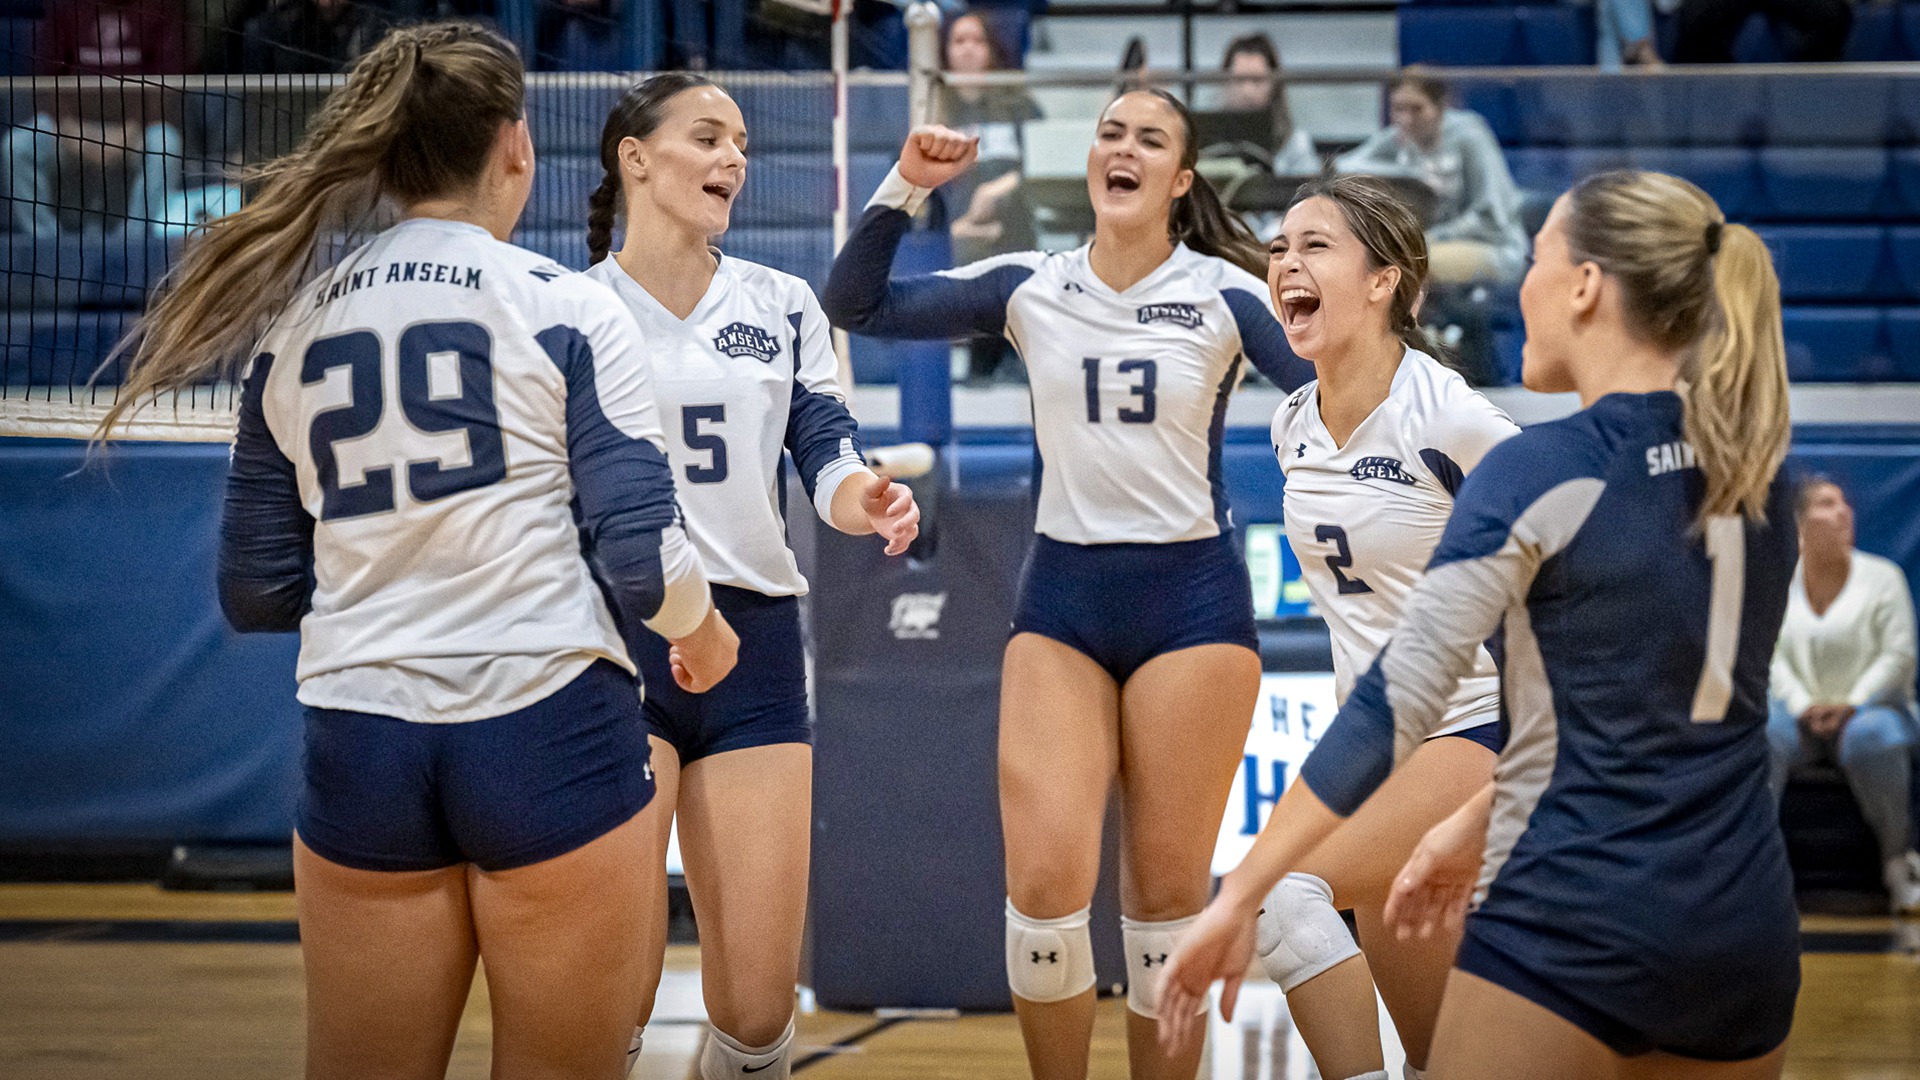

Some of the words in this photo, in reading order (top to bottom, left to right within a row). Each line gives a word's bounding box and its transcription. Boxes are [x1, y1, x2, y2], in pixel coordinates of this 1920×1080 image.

[314, 266, 379, 309] SAINT
[386, 262, 482, 290] ANSELM
[717, 331, 779, 352] ANSELM
[722, 323, 764, 338] SAINT
[299, 317, 508, 524] 29
[1082, 357, 1156, 423] 13
[681, 403, 729, 485] 5
[1645, 441, 1695, 477] SAIN
[1315, 524, 1376, 596] 2
[1690, 514, 1746, 724] 1
